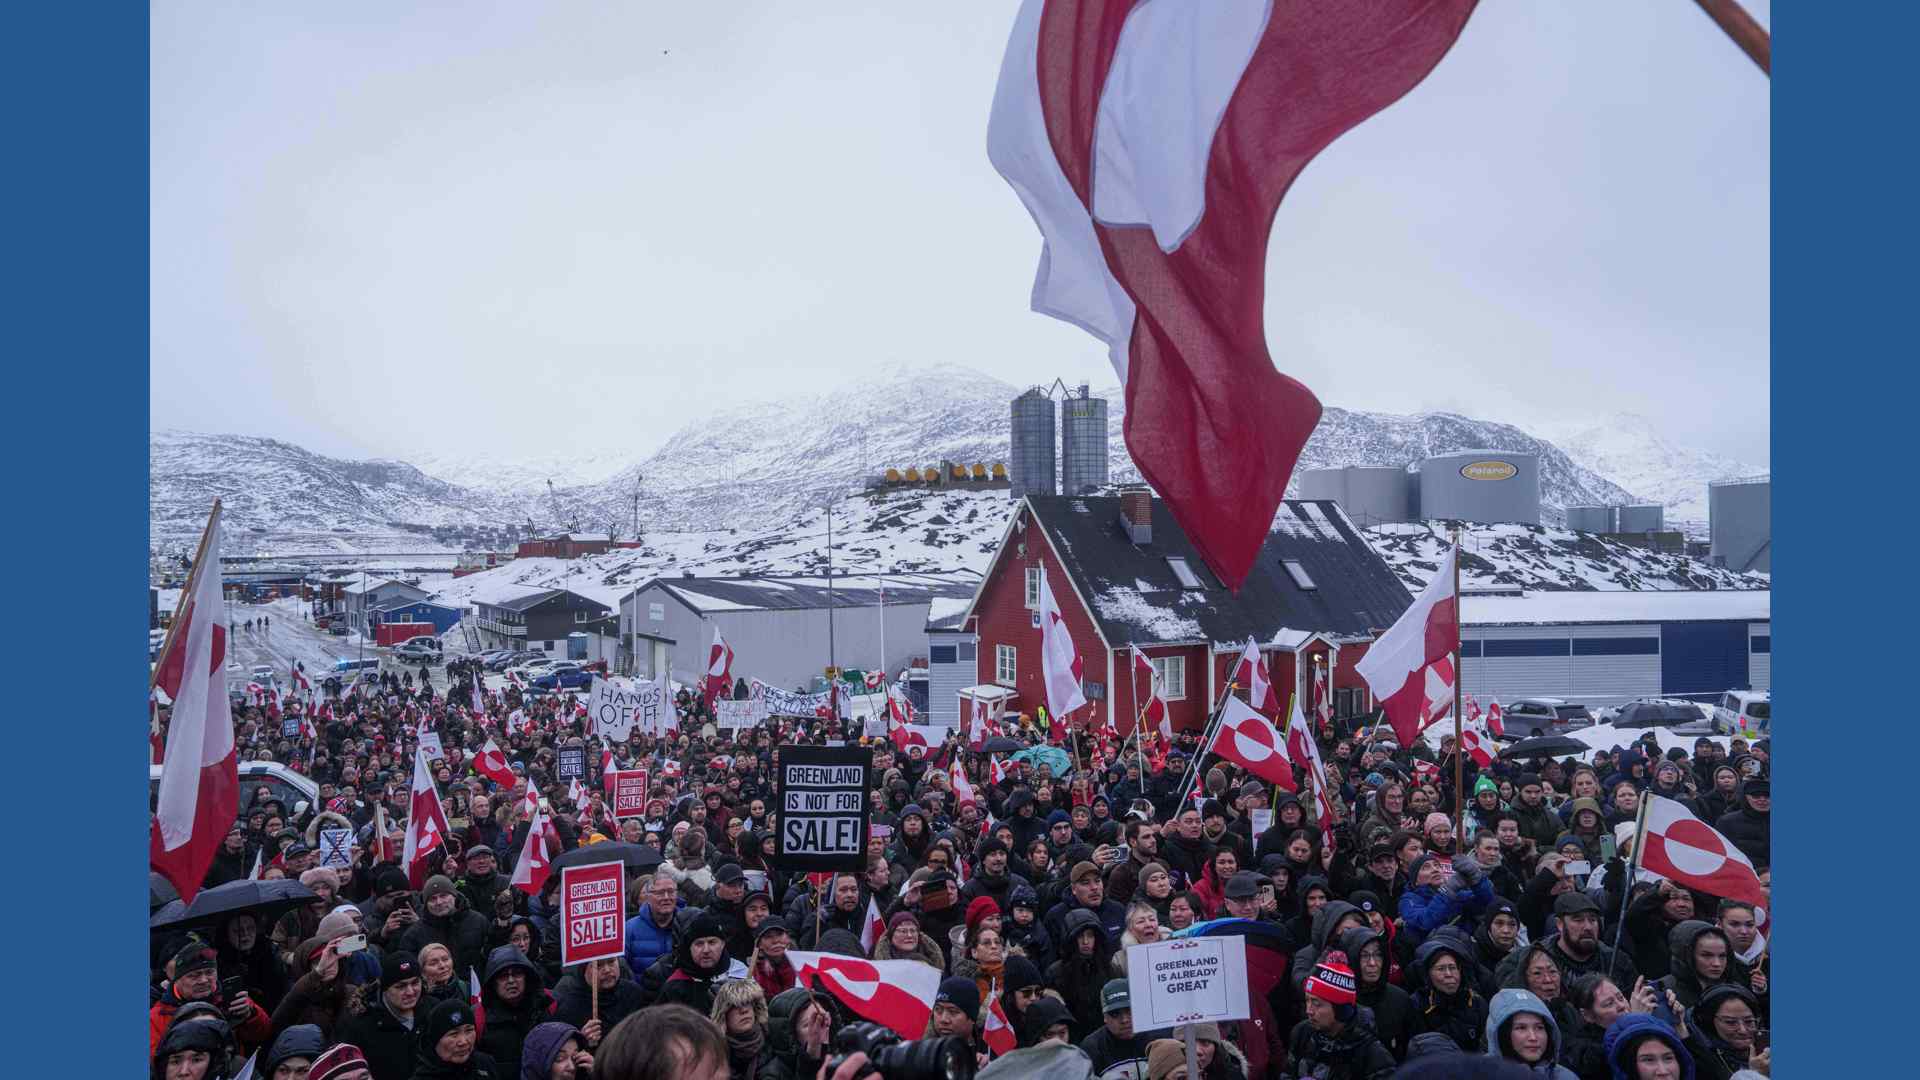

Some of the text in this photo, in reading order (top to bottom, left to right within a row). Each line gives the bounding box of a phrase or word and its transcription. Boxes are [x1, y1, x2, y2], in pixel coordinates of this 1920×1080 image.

[601, 687, 660, 704] HANDS
[600, 703, 658, 726] OFF!
[788, 767, 861, 784] GREENLAND
[787, 793, 859, 810] IS NOT FOR
[785, 819, 859, 852] SALE!
[572, 881, 616, 897] GREENLAND
[572, 897, 615, 914] IS NOT FOR
[573, 915, 616, 944] SALE!
[1155, 957, 1218, 971] GREENLAND
[1158, 968, 1217, 982] IS ALREADY
[1167, 980, 1208, 993] GREAT
